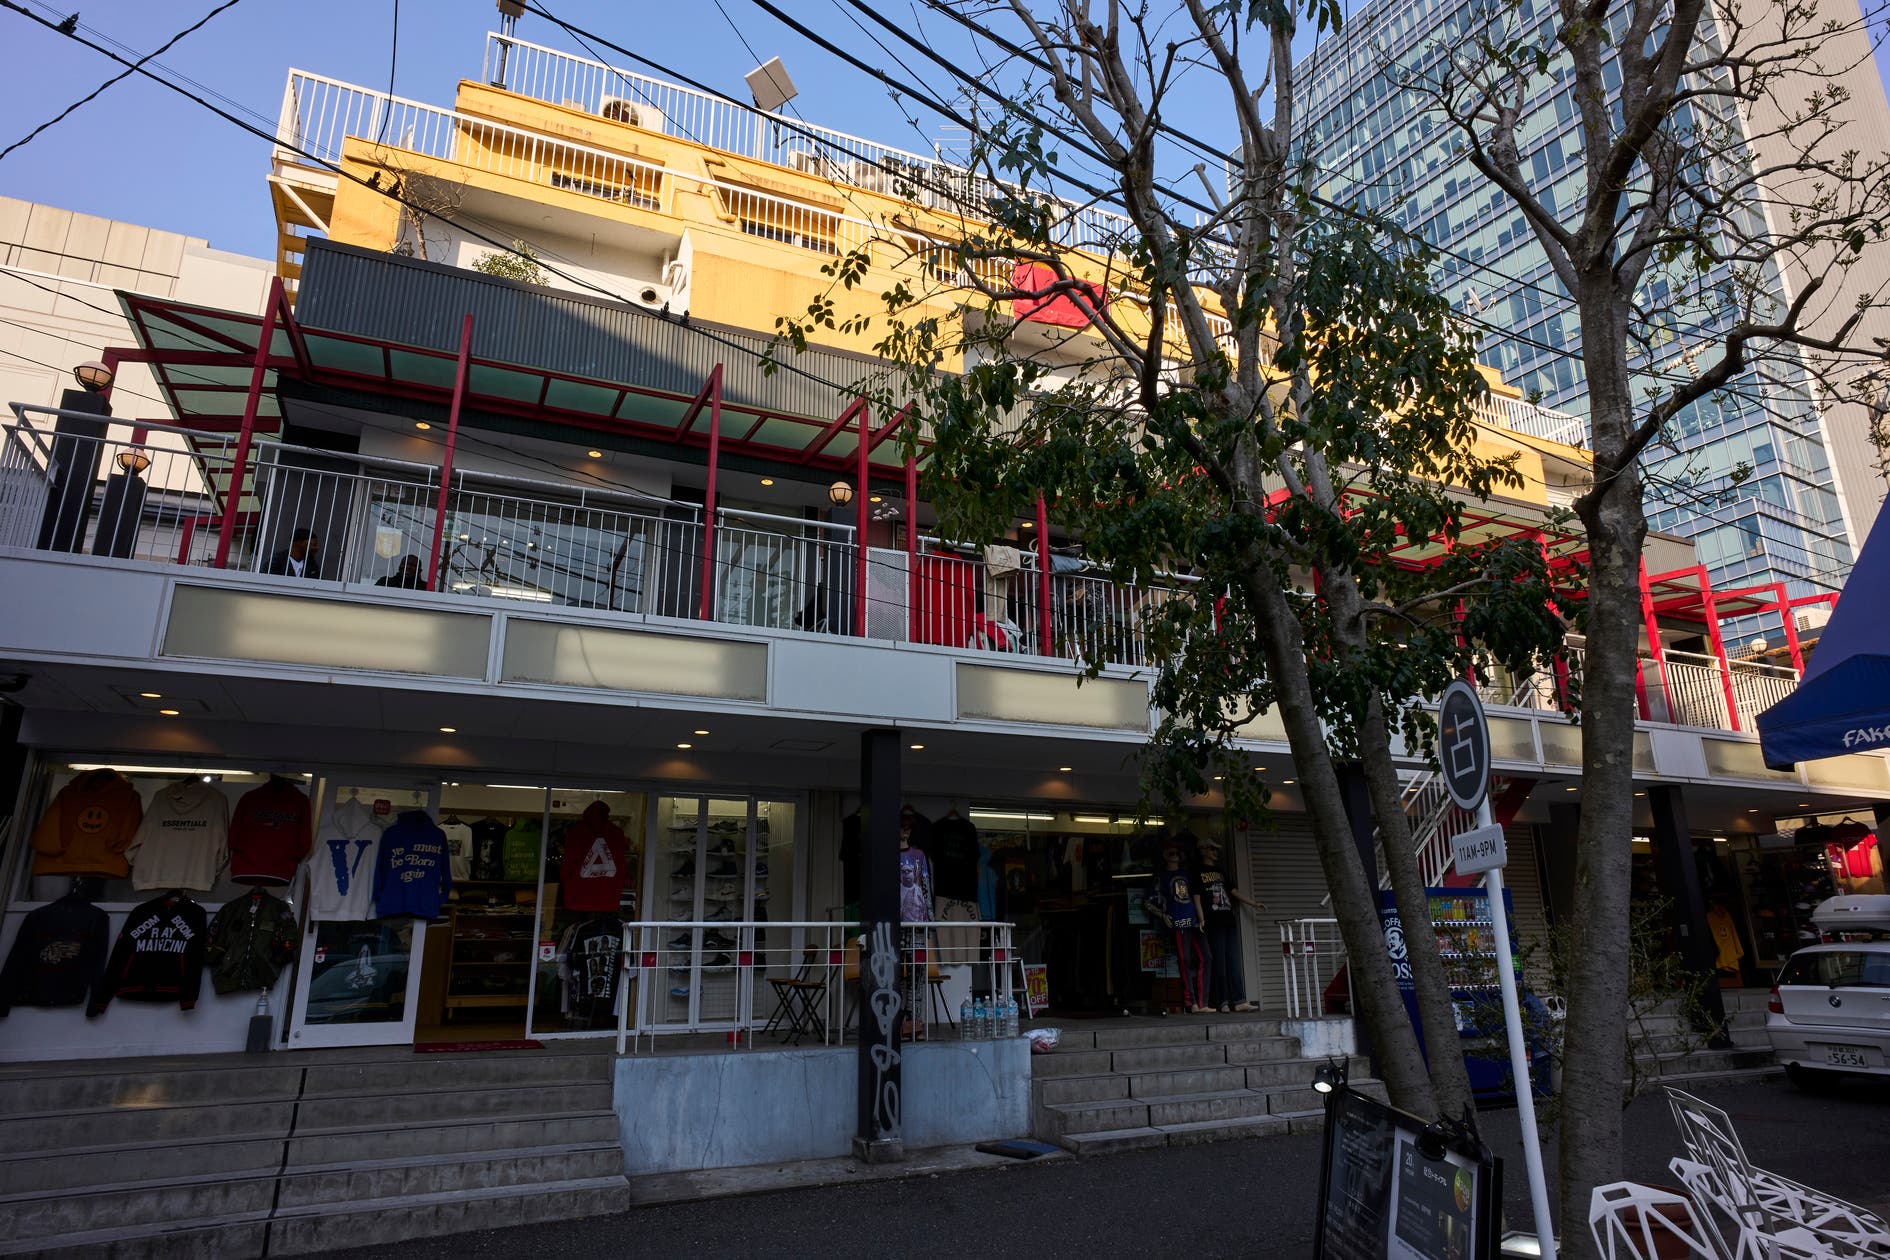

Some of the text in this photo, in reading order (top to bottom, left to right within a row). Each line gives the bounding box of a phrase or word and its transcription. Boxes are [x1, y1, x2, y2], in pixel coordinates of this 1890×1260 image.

[1451, 713, 1477, 780] 占
[412, 843, 442, 855] must
[1458, 844, 1497, 862] 11AM-9PM
[326, 839, 373, 896] V
[130, 914, 196, 940] BOOM BOOM
[150, 926, 178, 939] RAY
[136, 938, 188, 953] MANCINI
[1030, 993, 1048, 1005] OFF
